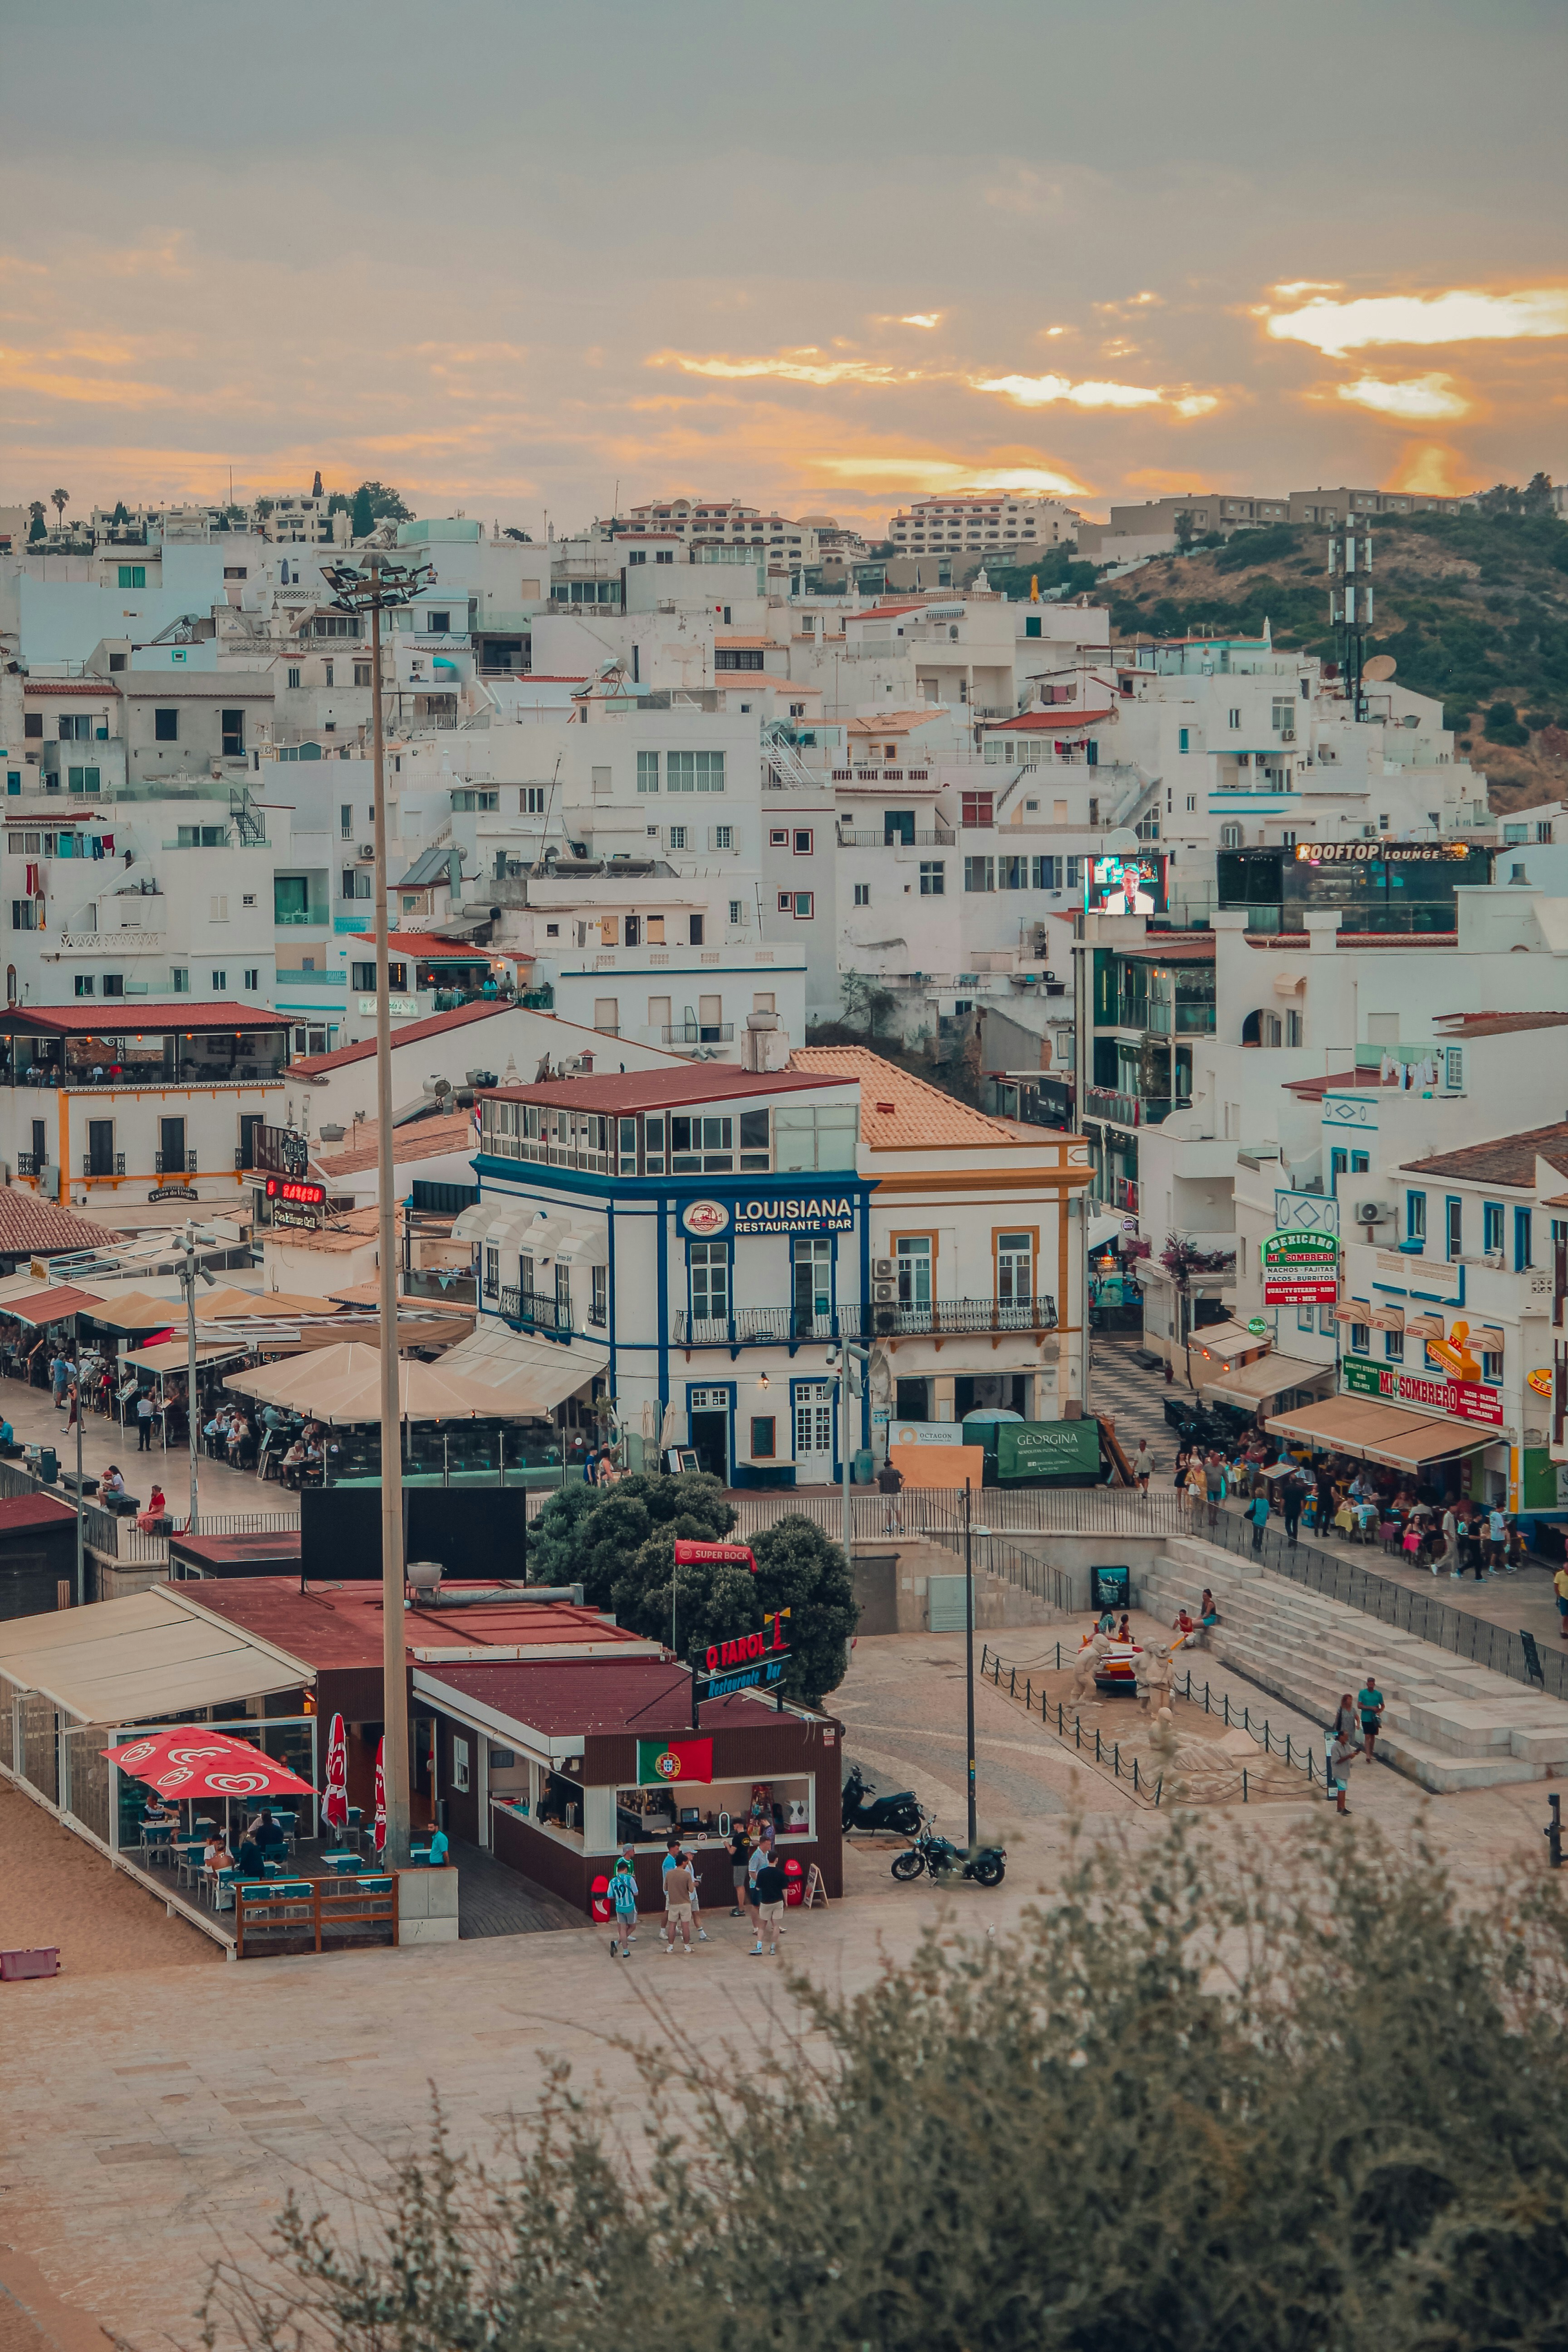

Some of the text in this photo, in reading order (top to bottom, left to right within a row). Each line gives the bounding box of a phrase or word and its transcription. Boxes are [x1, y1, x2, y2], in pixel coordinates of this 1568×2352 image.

[1298, 844, 1439, 860] ROOFTOP LOUNGE
[151, 1191, 168, 1200] Tasca
[177, 1190, 196, 1199] Viegas
[735, 1198, 852, 1220] LOUISIANA
[734, 1219, 852, 1233] RESTAURANTE BAR
[1268, 1234, 1334, 1251] MEXICANO
[1267, 1253, 1334, 1263] MI SOMBRERO
[1345, 1362, 1378, 1374] QUALITY STEAKS
[1352, 1381, 1371, 1391] TEX-MEX
[1379, 1370, 1457, 1411] MI SOMBRERO
[1464, 1390, 1496, 1403] TACOS FAJITAS
[1460, 1397, 1501, 1412] NACHOS BURRITOS
[1467, 1407, 1494, 1420] ENCHILADAS
[1017, 1433, 1078, 1446] GEORGINA
[695, 1550, 723, 1559] SUPER
[724, 1551, 748, 1560] BOCK
[706, 1632, 766, 1670] O FAROL
[708, 1663, 782, 1698] Restaurante Bar
[614, 1884, 627, 1899] 19
